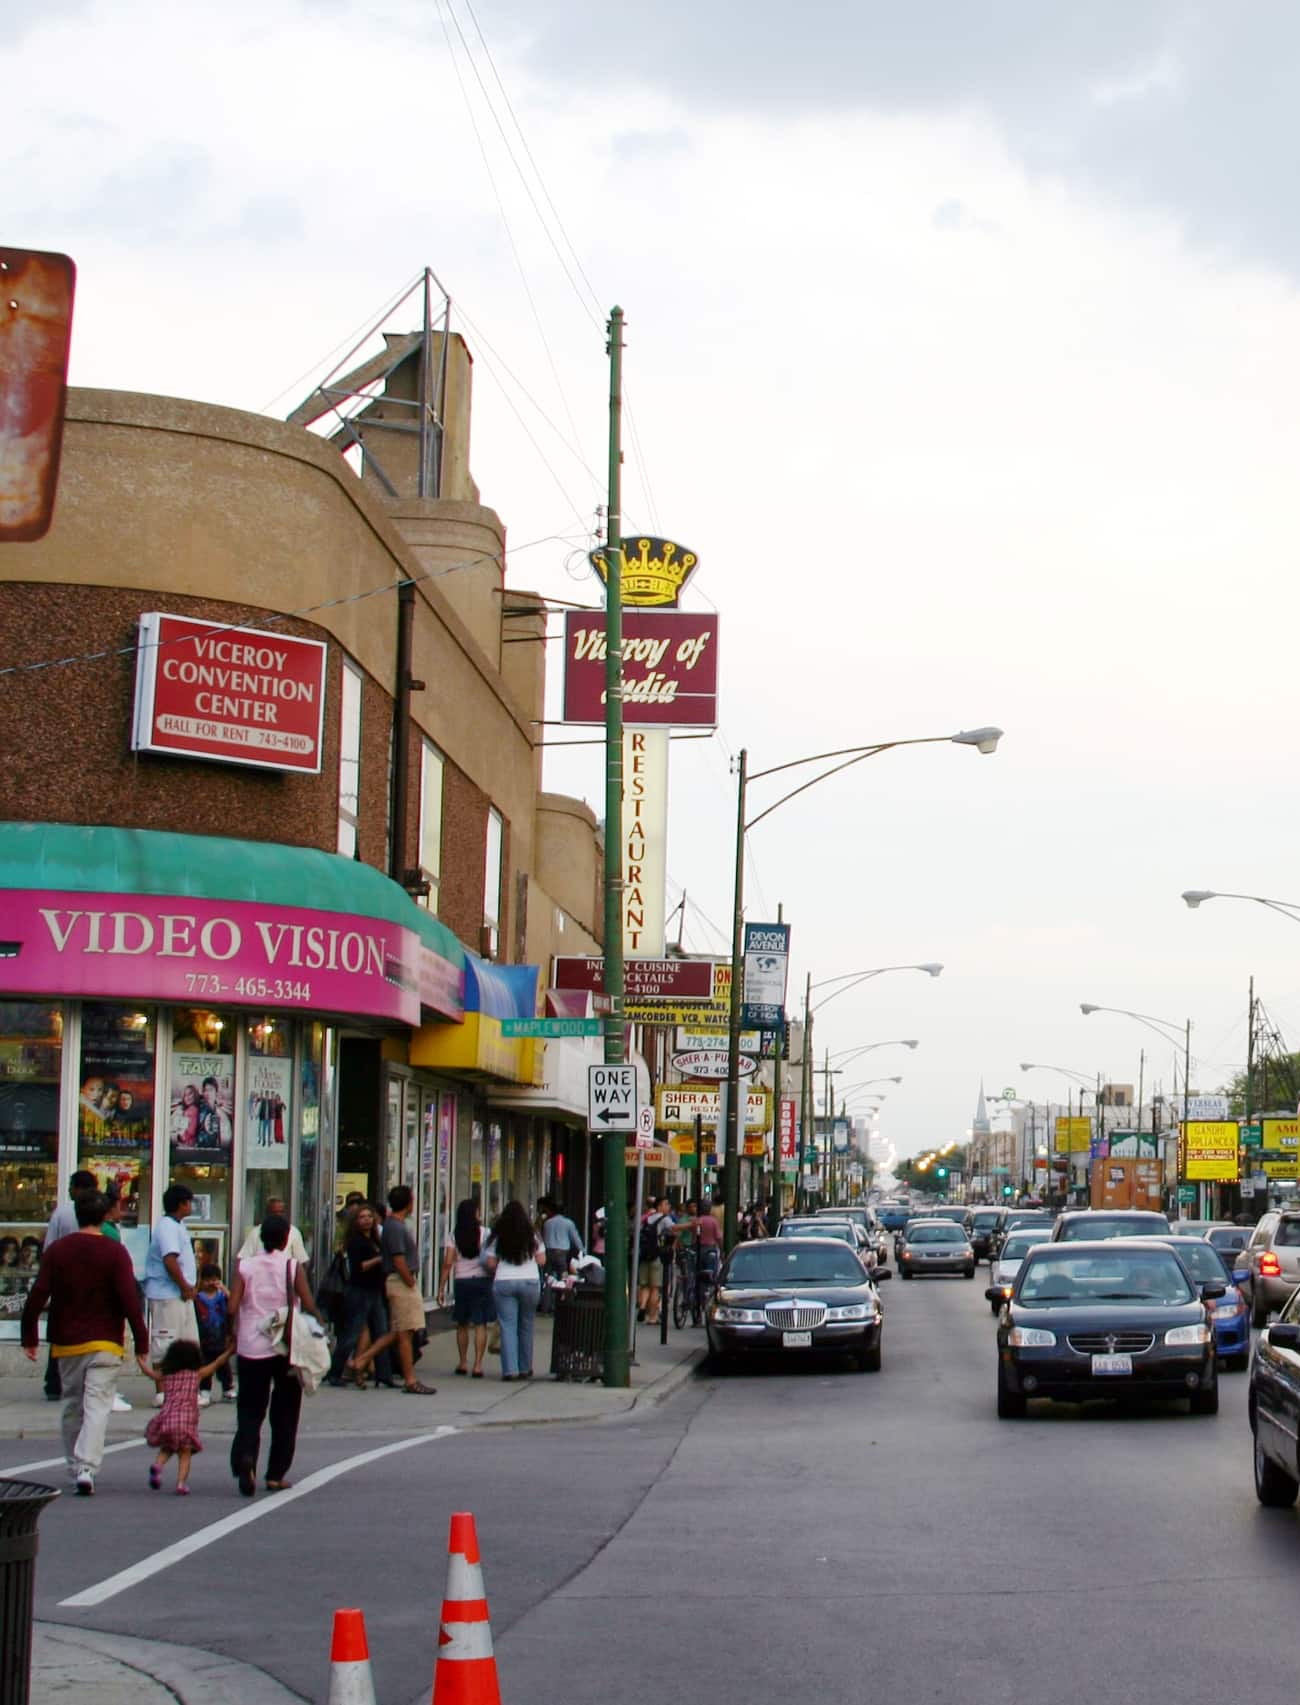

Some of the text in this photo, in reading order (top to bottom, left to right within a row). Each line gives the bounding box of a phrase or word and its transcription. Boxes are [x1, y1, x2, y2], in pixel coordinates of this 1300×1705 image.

[193, 636, 288, 672] VICEROY
[676, 632, 711, 670] of
[163, 659, 313, 702] CONVENTION
[601, 669, 679, 704] ndia
[195, 692, 277, 724] CENTER
[164, 717, 307, 750] HALL FOR RENT 743-4100
[626, 733, 645, 950] RESTAURANT
[39, 907, 387, 977] VIDEO VISION
[750, 931, 785, 941] DEVON
[749, 941, 785, 951] AVENUE
[587, 960, 681, 973] INN CUISINE
[624, 972, 674, 984] CKTAILS
[704, 1014, 729, 1024] WATC
[513, 1021, 585, 1033] MAPLEWOOD
[181, 1061, 222, 1075] TAXI
[595, 1071, 631, 1086] ONE
[594, 1089, 632, 1103] WAY
